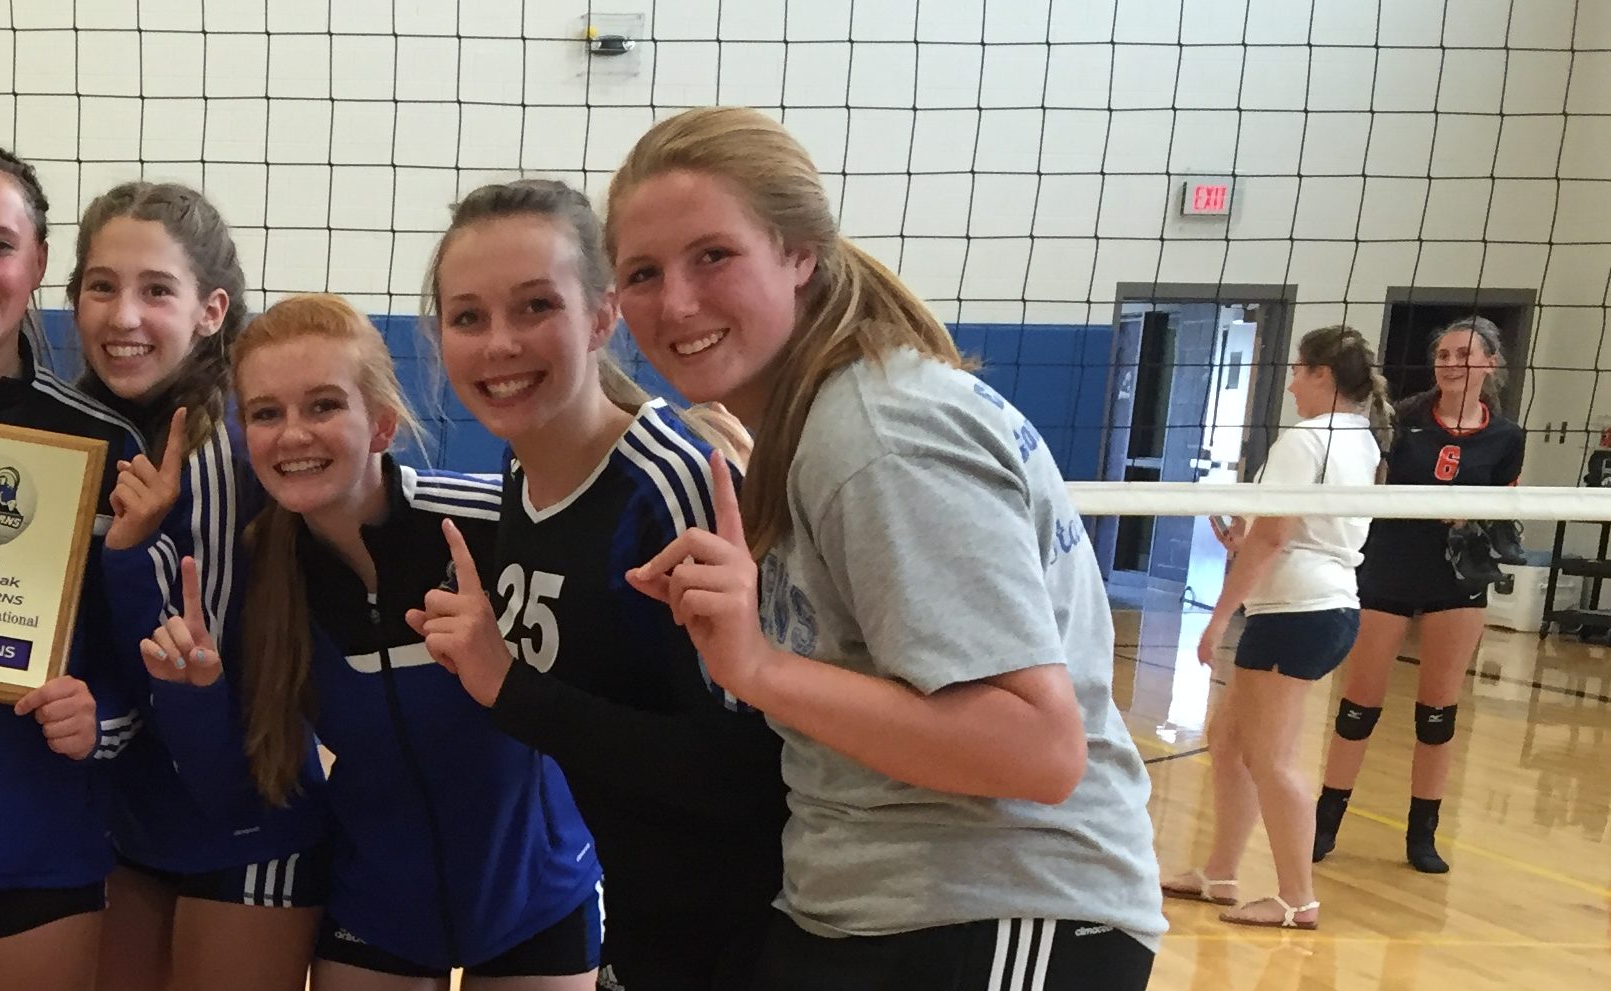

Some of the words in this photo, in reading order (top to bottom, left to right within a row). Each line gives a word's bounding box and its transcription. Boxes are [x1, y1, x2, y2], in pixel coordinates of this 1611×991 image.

[1194, 186, 1226, 209] EXIT
[1434, 445, 1461, 481] 6
[496, 563, 565, 673] 25
